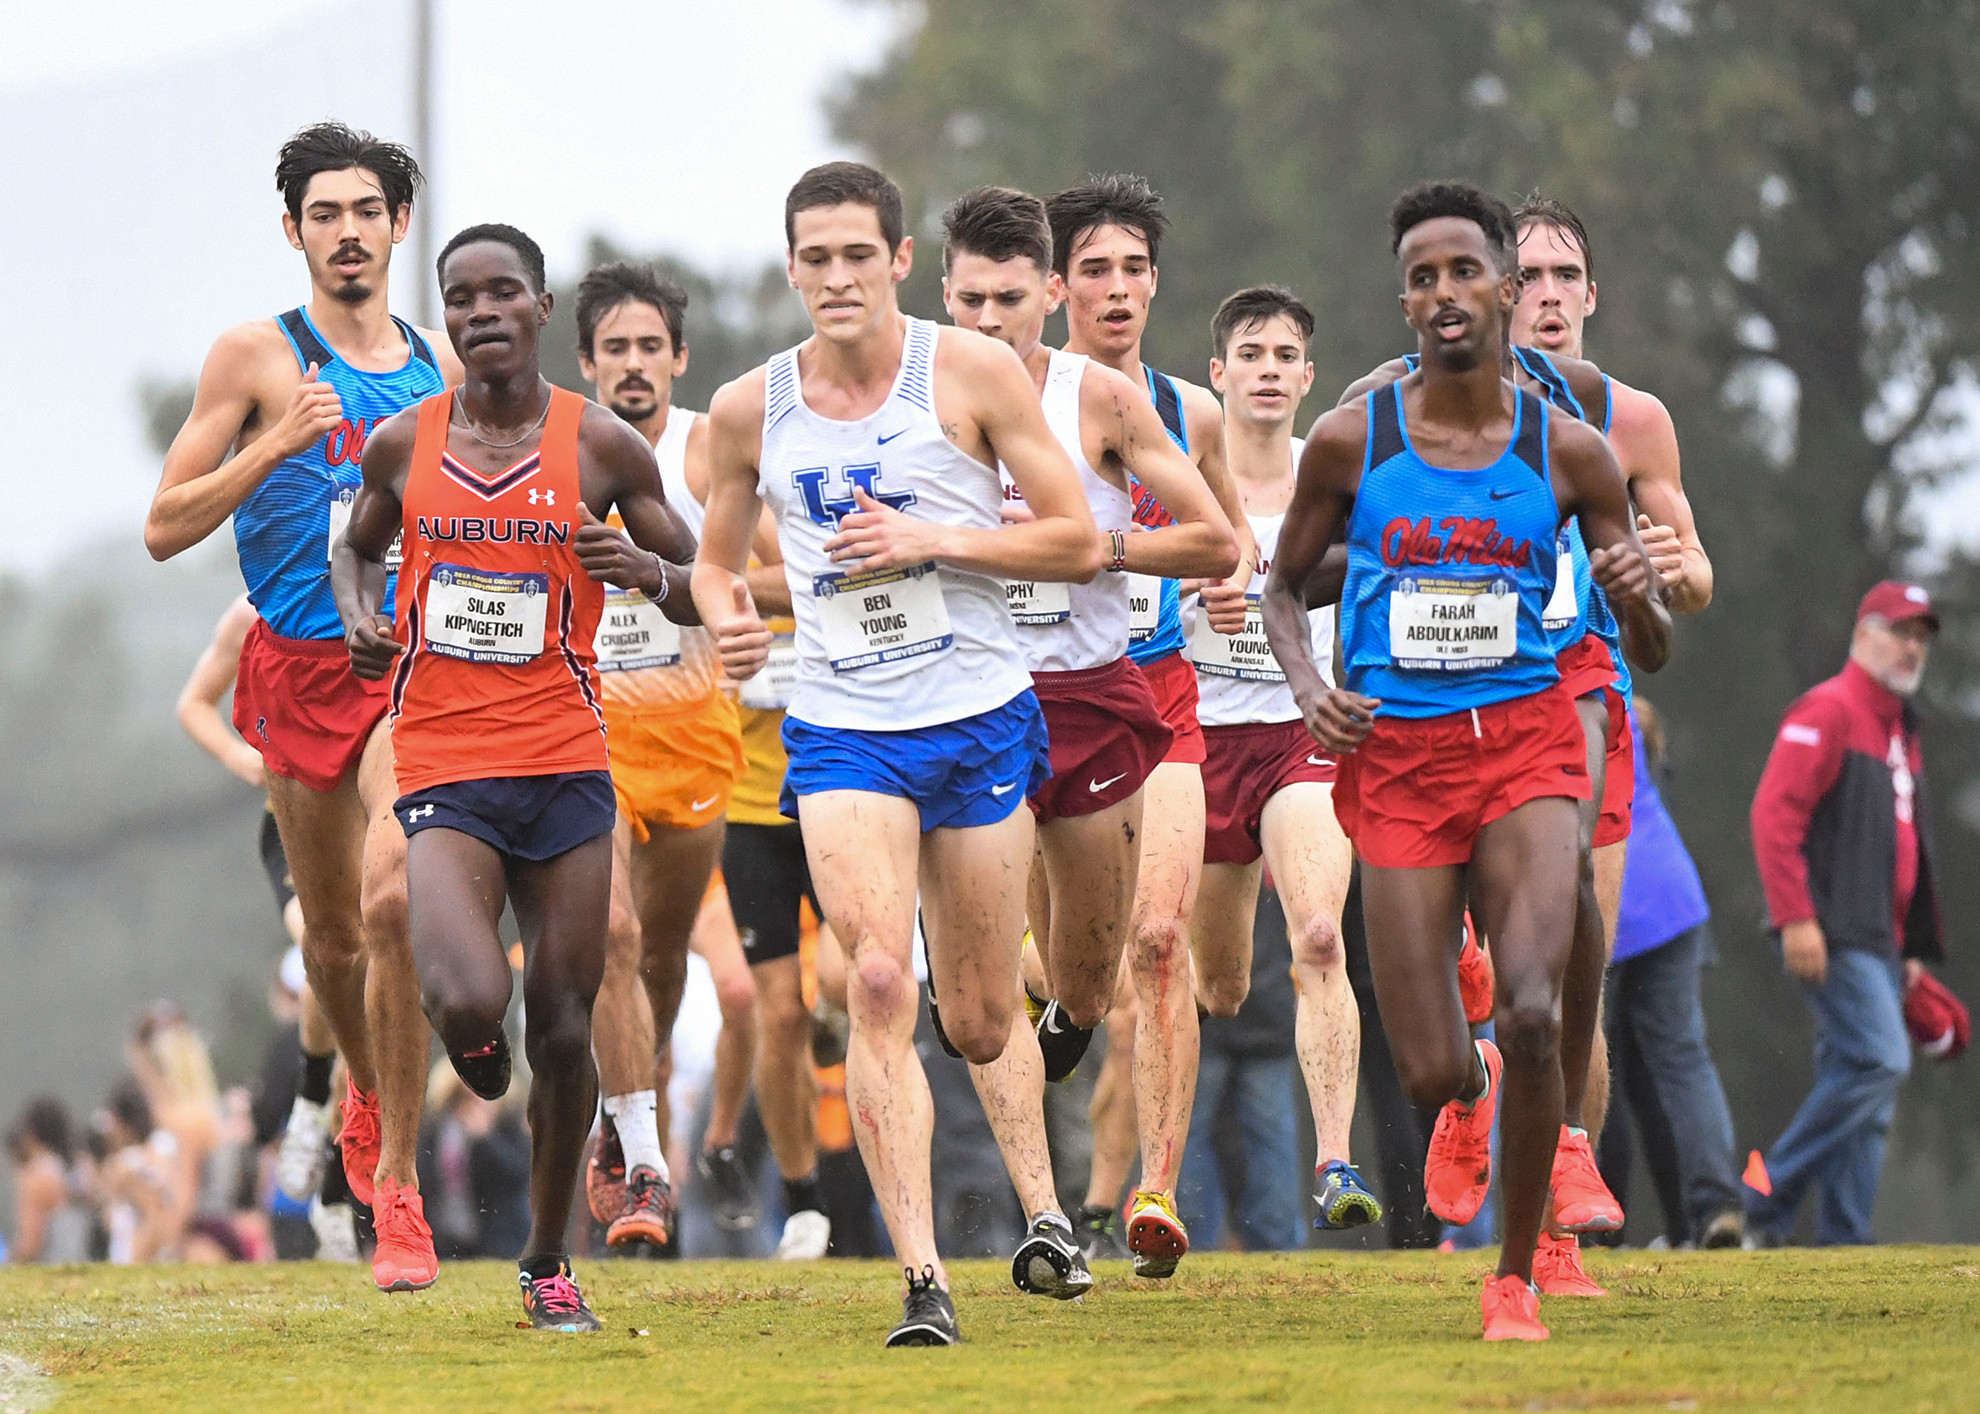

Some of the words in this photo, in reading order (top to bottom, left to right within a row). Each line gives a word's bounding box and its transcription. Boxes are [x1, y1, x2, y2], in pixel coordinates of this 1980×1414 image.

[325, 416, 365, 466] Ol
[417, 516, 570, 545] AUBURN
[1381, 517, 1442, 567] Ole
[1439, 517, 1531, 568] Miss
[456, 579, 520, 592] CHAMPIONSHIPS
[467, 597, 505, 616] SILAS
[863, 593, 892, 613] BEN
[1431, 604, 1475, 619] FARAH
[445, 614, 524, 637] KIPNGETICH
[610, 613, 638, 627] ALEX
[859, 613, 907, 636] YOUNG
[601, 631, 650, 647] CRIGGER
[869, 633, 905, 647] KENTUCKY
[1406, 625, 1498, 641] ABDULKARIM
[468, 637, 496, 647] AUBURN
[1229, 639, 1270, 655] YOUNG
[431, 643, 470, 659] AUBURN
[473, 652, 532, 664] UNIVERSITY
[836, 653, 880, 671] AUBURN
[882, 638, 943, 661] UNIVERSITY
[1231, 656, 1264, 665] ARKANSAS
[1200, 664, 1236, 676] AUBURN
[1399, 659, 1441, 670] AUBURN
[1445, 658, 1503, 670] UNIVERSITY
